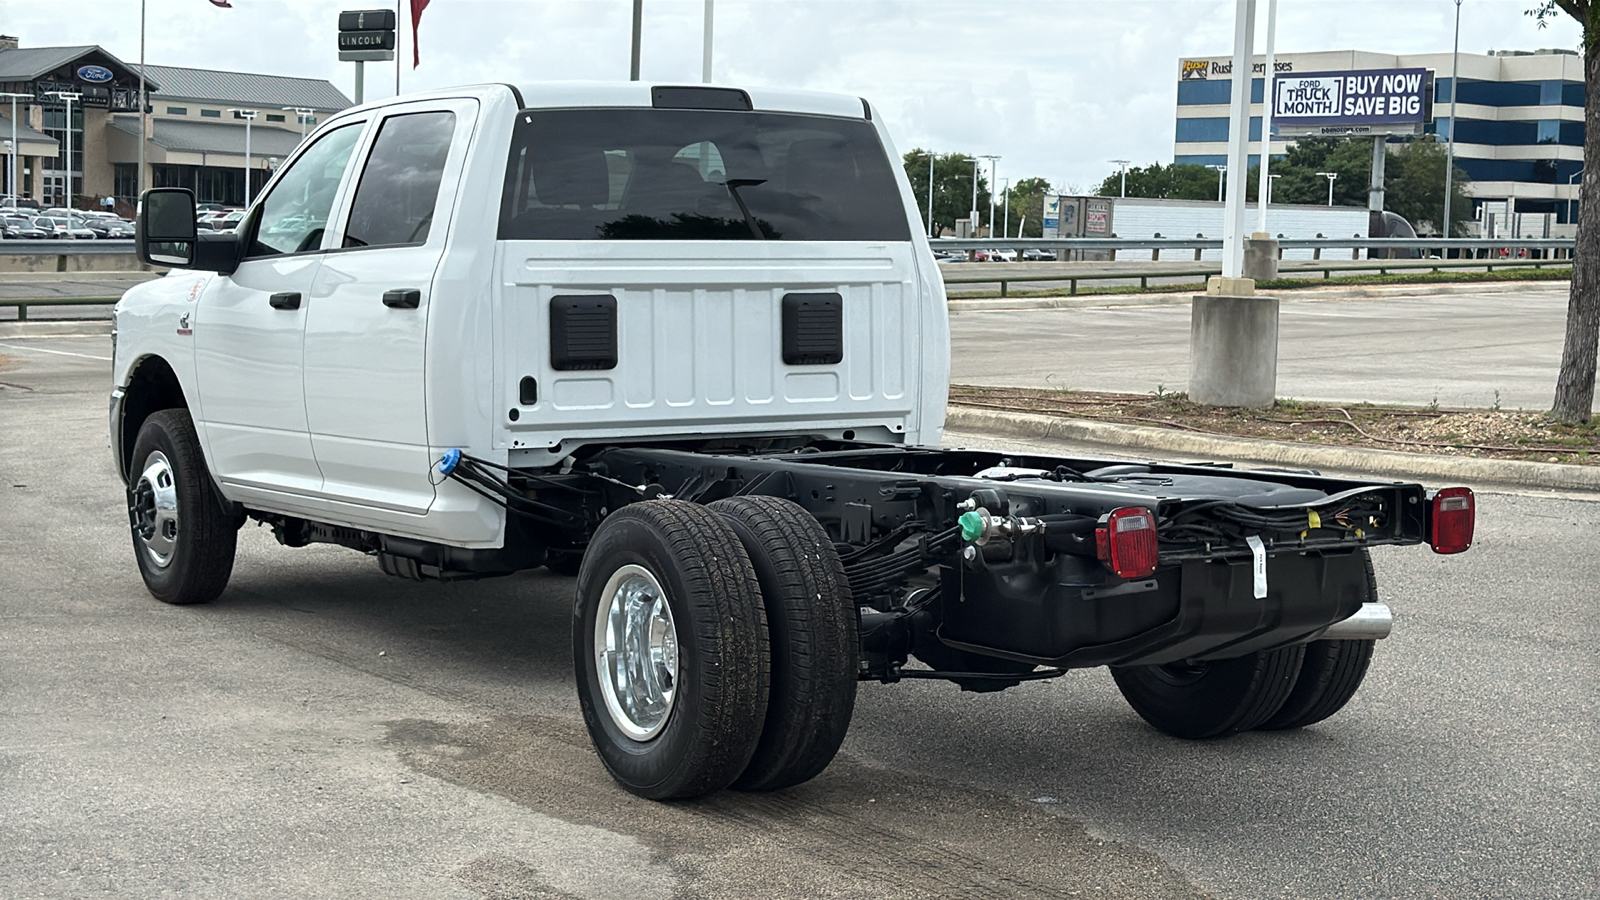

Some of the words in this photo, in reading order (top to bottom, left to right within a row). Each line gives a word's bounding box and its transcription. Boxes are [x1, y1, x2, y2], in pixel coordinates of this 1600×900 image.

[341, 36, 382, 46] LINCOLN
[1299, 80, 1321, 88] FORD
[1346, 75, 1380, 95] BUY
[1381, 74, 1422, 94] NOW
[1287, 87, 1331, 102] TRUCK
[1284, 101, 1333, 114] MONTH
[1344, 96, 1386, 116] SAVE
[1388, 96, 1421, 115] BIG
